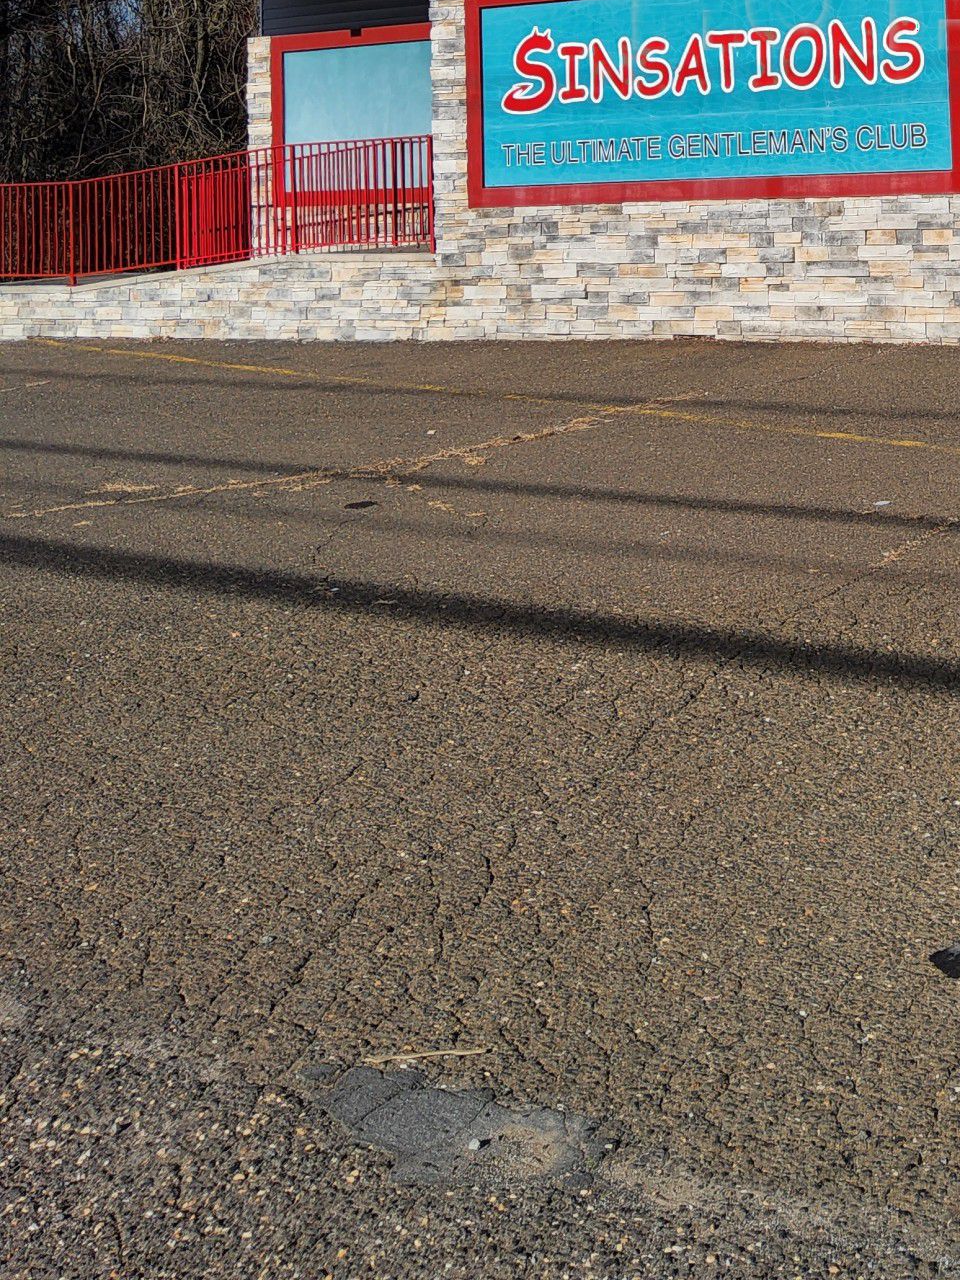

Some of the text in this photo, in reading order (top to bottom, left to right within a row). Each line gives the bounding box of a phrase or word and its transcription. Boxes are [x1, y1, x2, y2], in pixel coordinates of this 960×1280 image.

[501, 17, 925, 115] SINSATIONS
[500, 122, 929, 167] THE ULTIMATE GENTLEMAN'S CLUB
